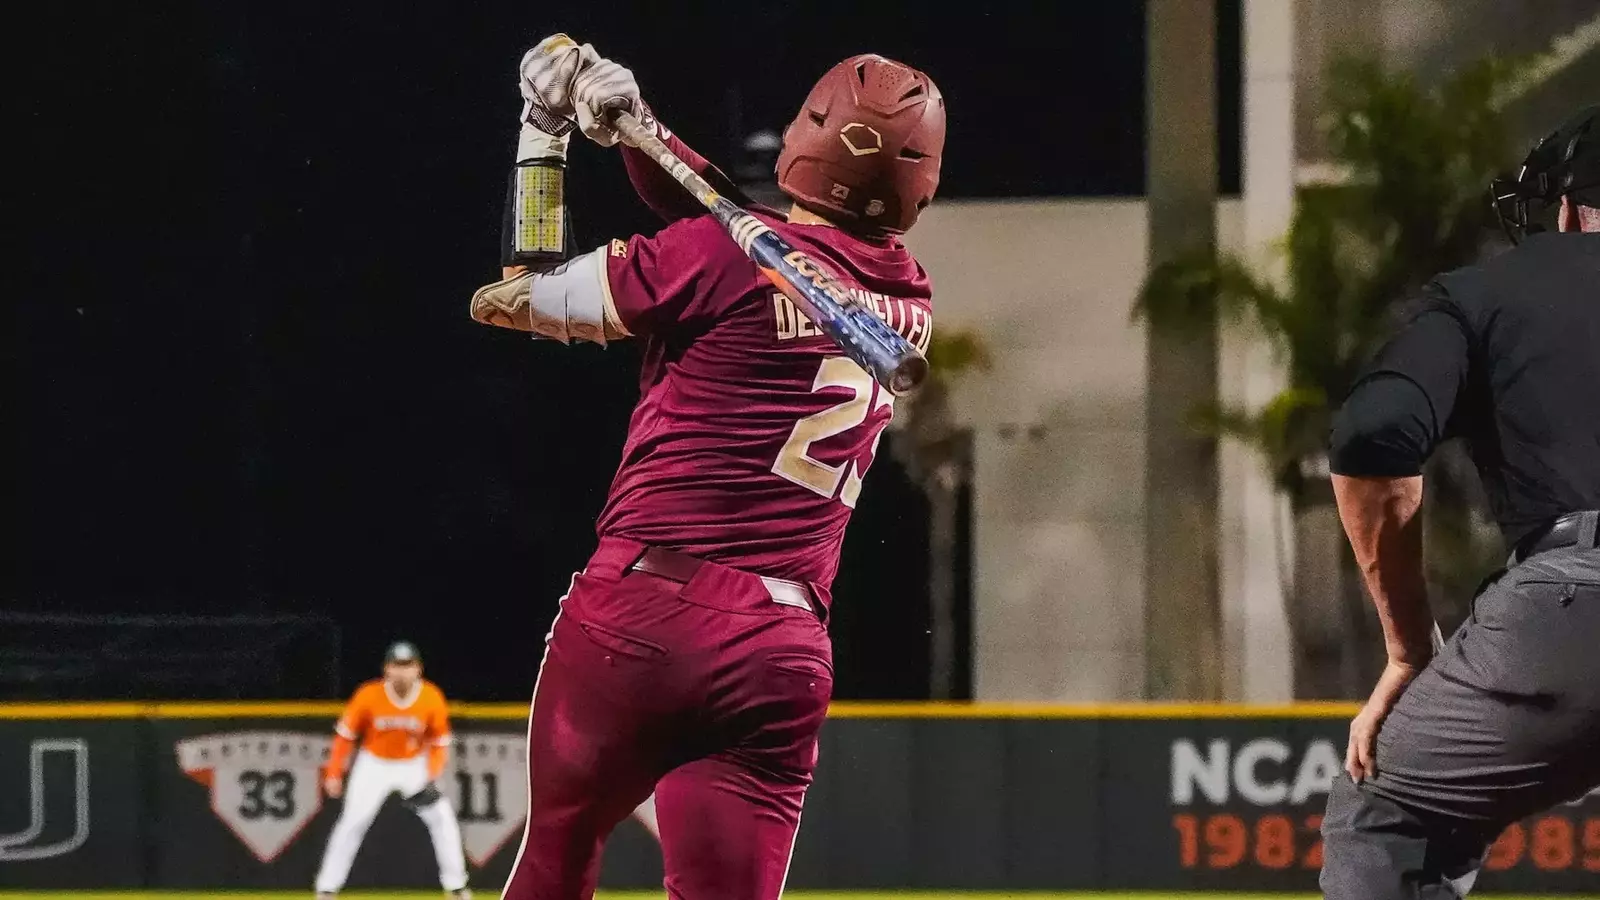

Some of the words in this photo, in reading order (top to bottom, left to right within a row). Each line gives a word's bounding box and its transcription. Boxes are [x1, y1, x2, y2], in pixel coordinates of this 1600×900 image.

[238, 769, 296, 820] 33
[456, 769, 503, 821] 11
[1171, 738, 1339, 804] NCA
[1484, 815, 1600, 872] 98
